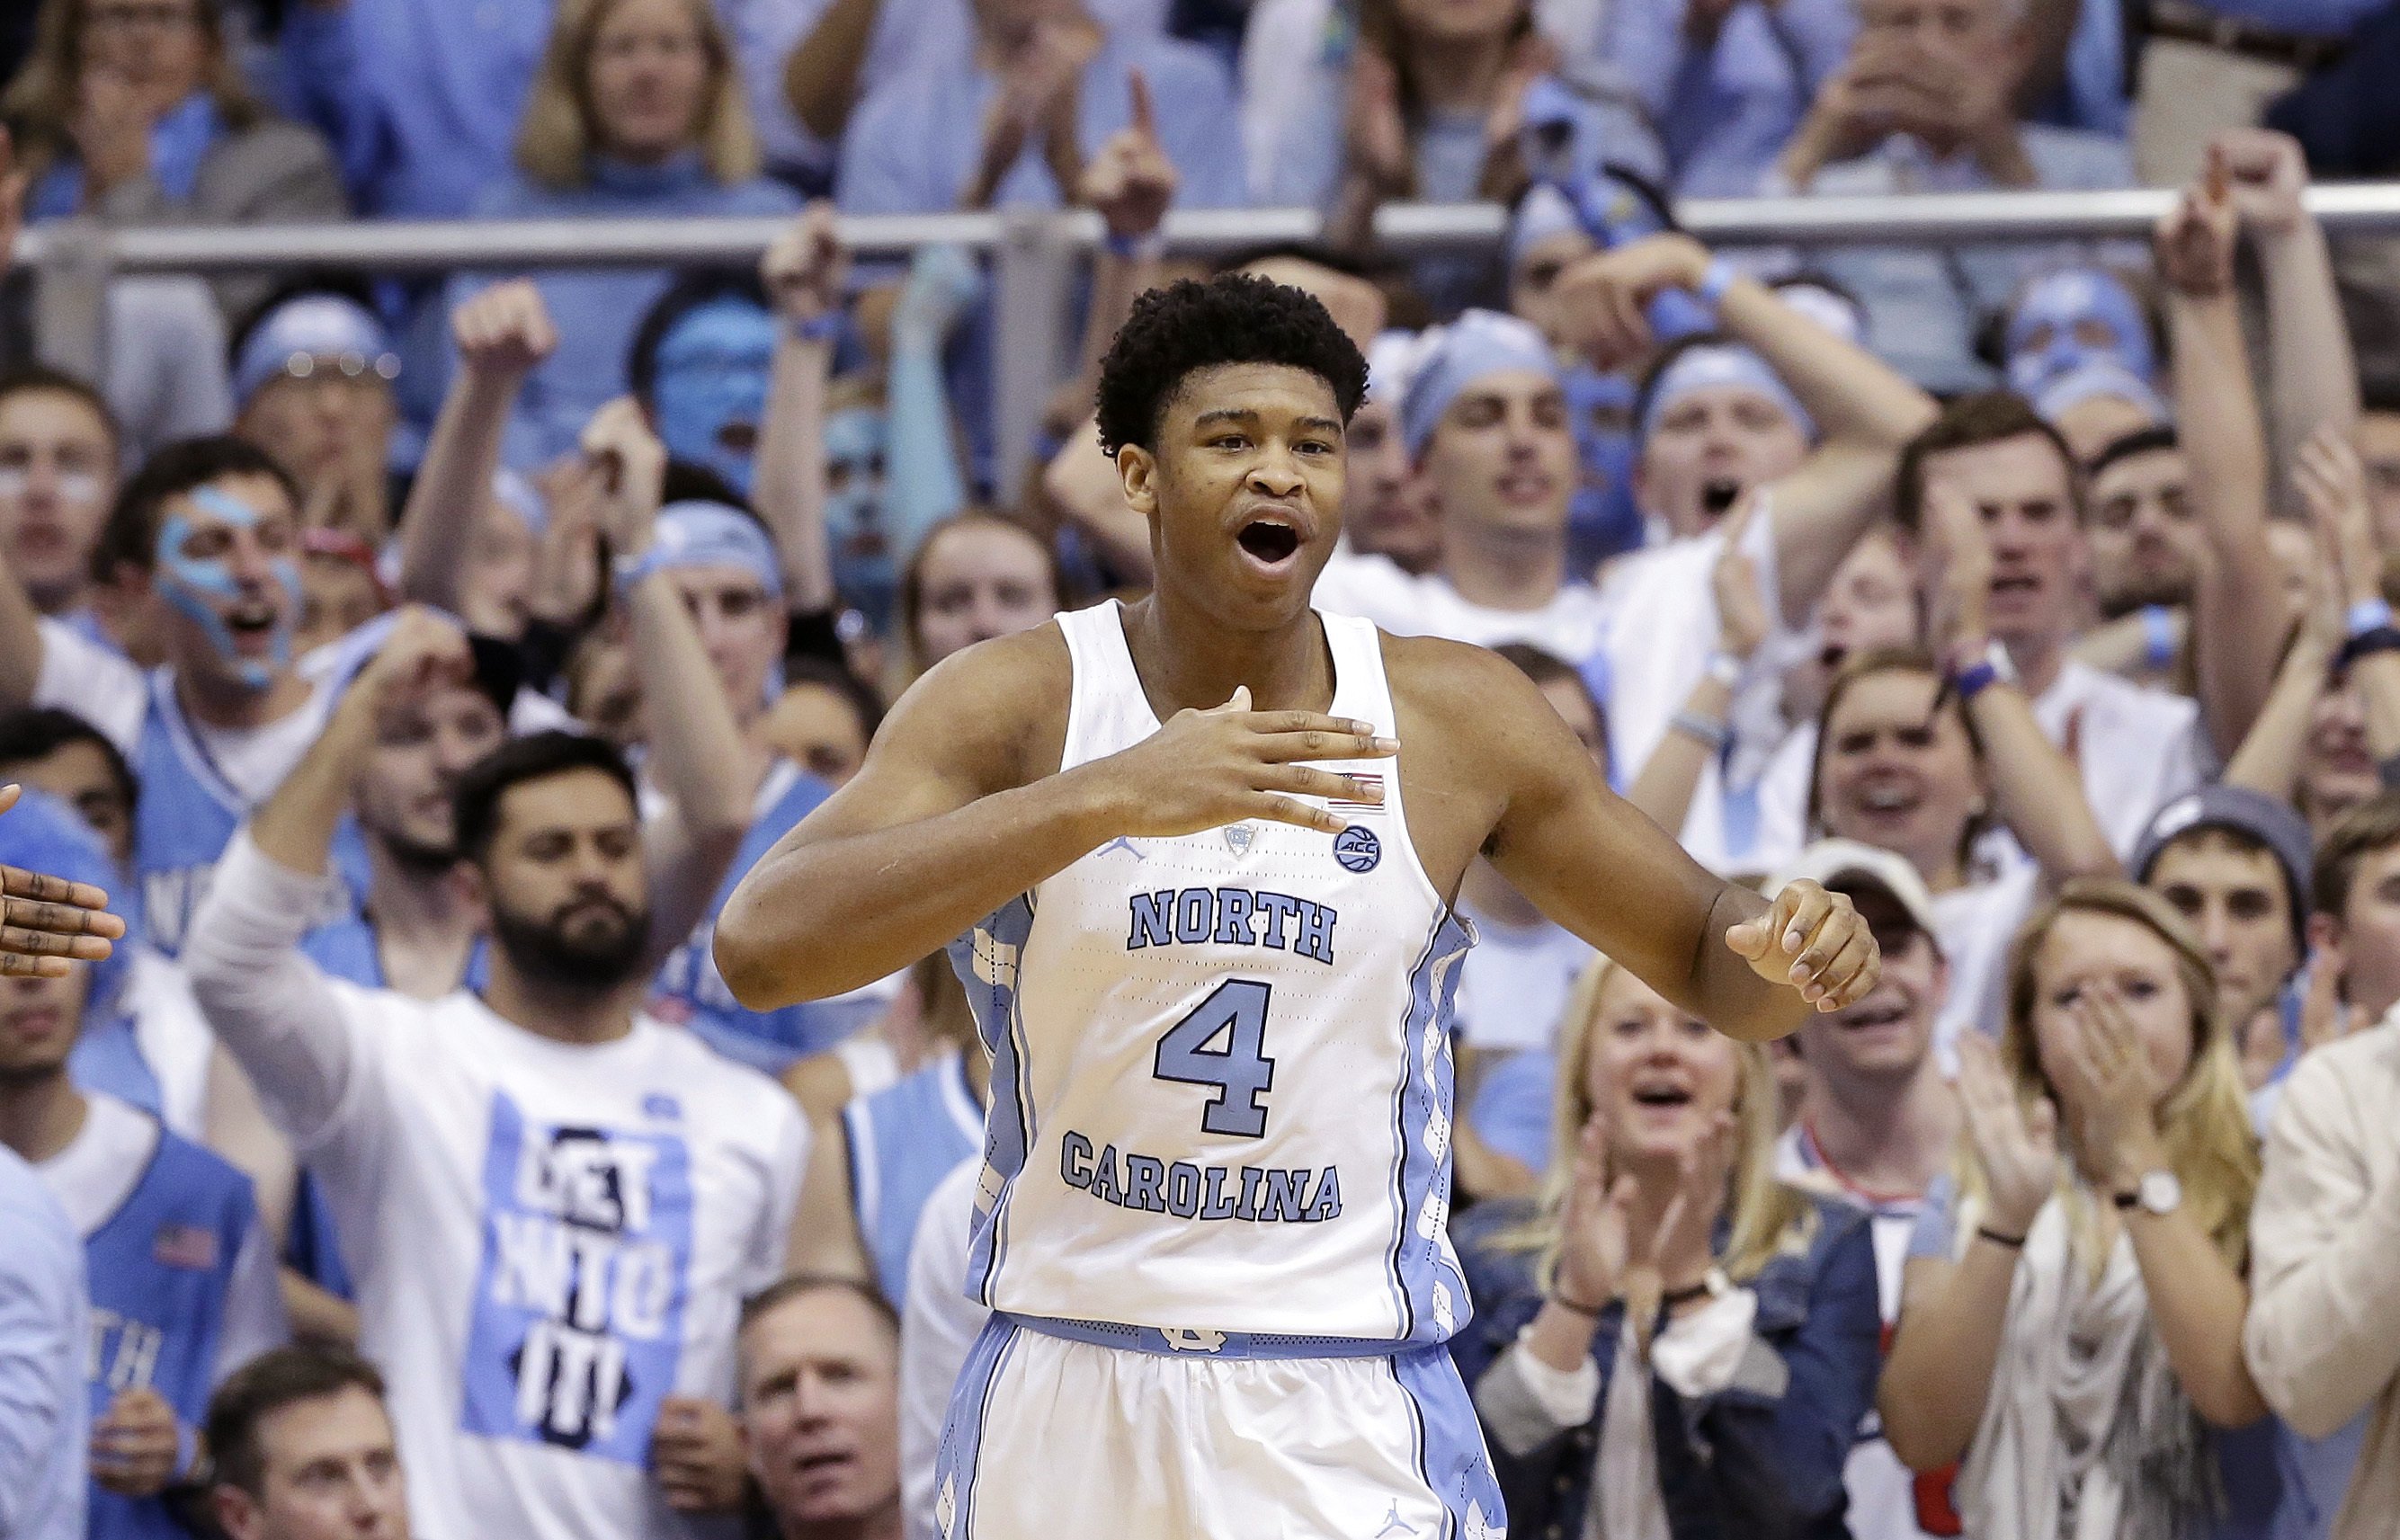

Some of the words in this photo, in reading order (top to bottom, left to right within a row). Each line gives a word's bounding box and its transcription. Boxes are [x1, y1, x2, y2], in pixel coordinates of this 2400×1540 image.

[1341, 841, 1378, 853] ACC
[1127, 886, 1337, 966] NORTH
[1154, 978, 1275, 1139] 4
[1061, 1130, 1343, 1223] CAROLINA
